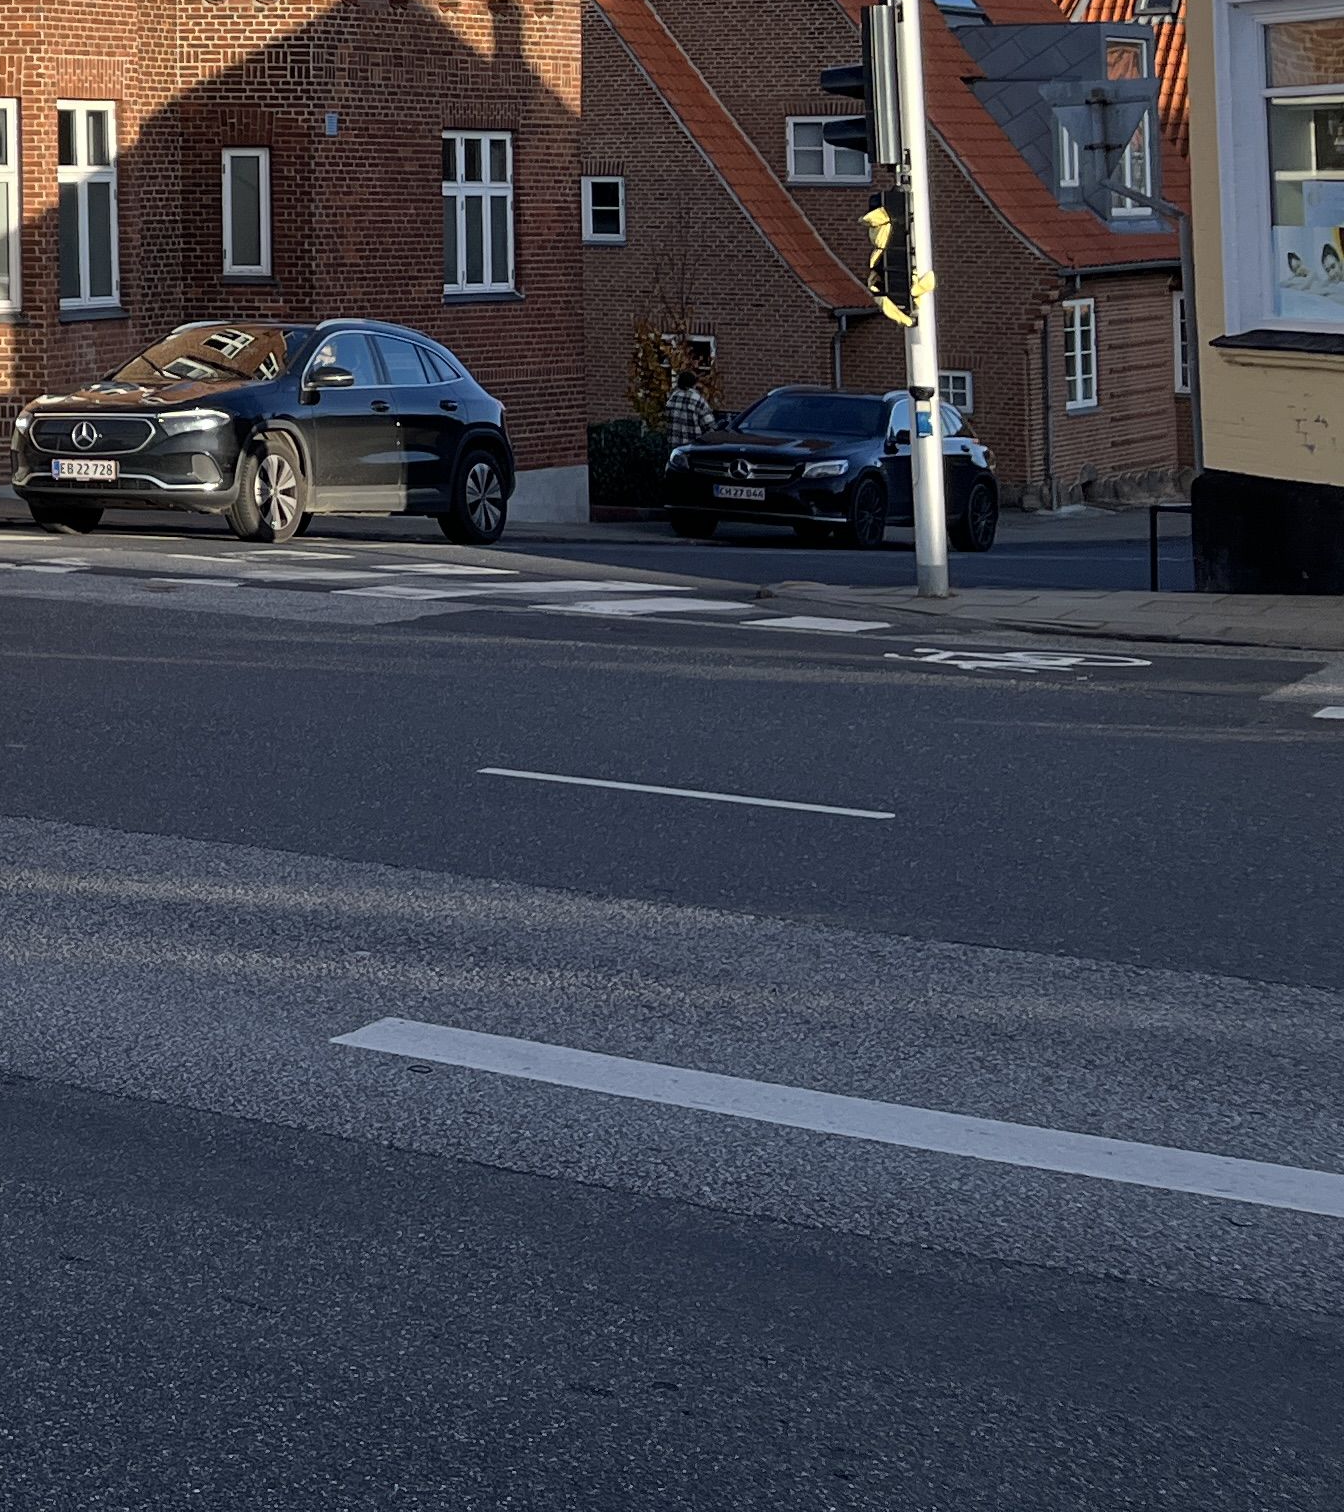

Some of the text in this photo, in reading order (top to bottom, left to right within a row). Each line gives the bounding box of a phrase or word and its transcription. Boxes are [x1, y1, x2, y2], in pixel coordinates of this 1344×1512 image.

[60, 462, 113, 476] EB 22 728
